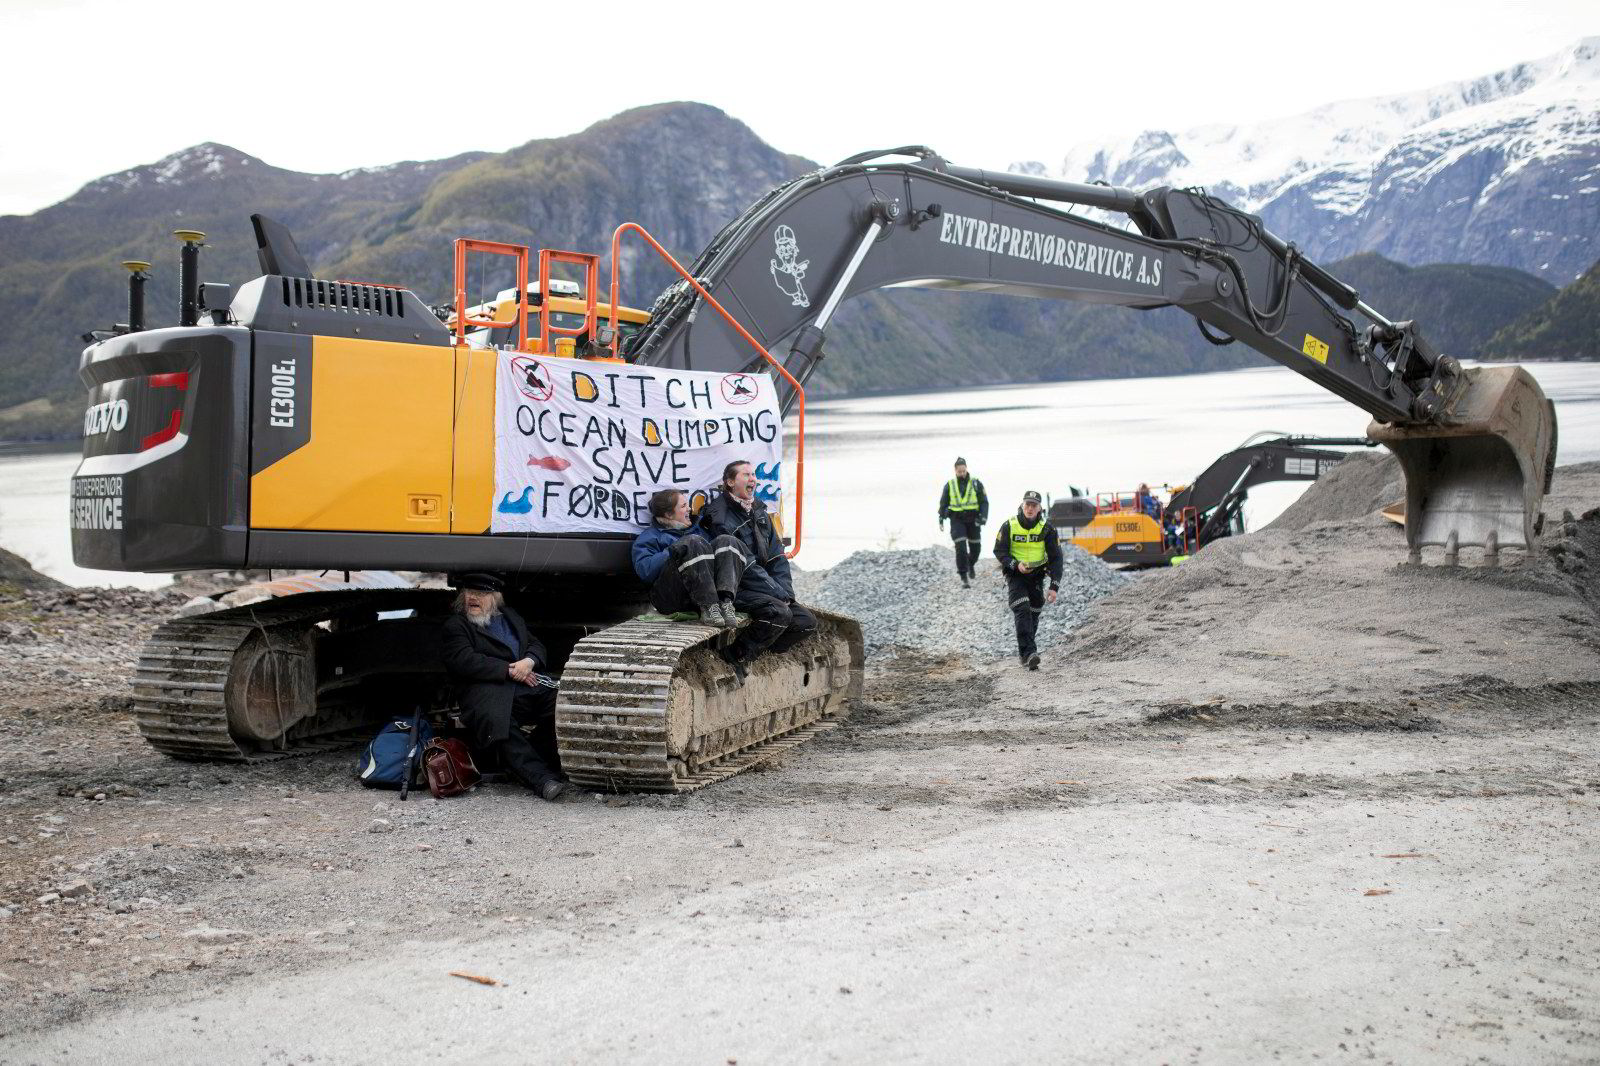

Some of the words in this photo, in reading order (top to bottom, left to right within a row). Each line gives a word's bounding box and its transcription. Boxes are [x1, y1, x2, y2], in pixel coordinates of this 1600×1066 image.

[940, 212, 1134, 281] ENTREPRENØRSERVICE
[571, 369, 713, 410] DITCH
[84, 398, 129, 437] OLVO
[516, 404, 627, 449] OCEAN
[641, 409, 777, 450] DUMPING
[592, 446, 690, 486] SAVE
[75, 497, 123, 530] SERVICE
